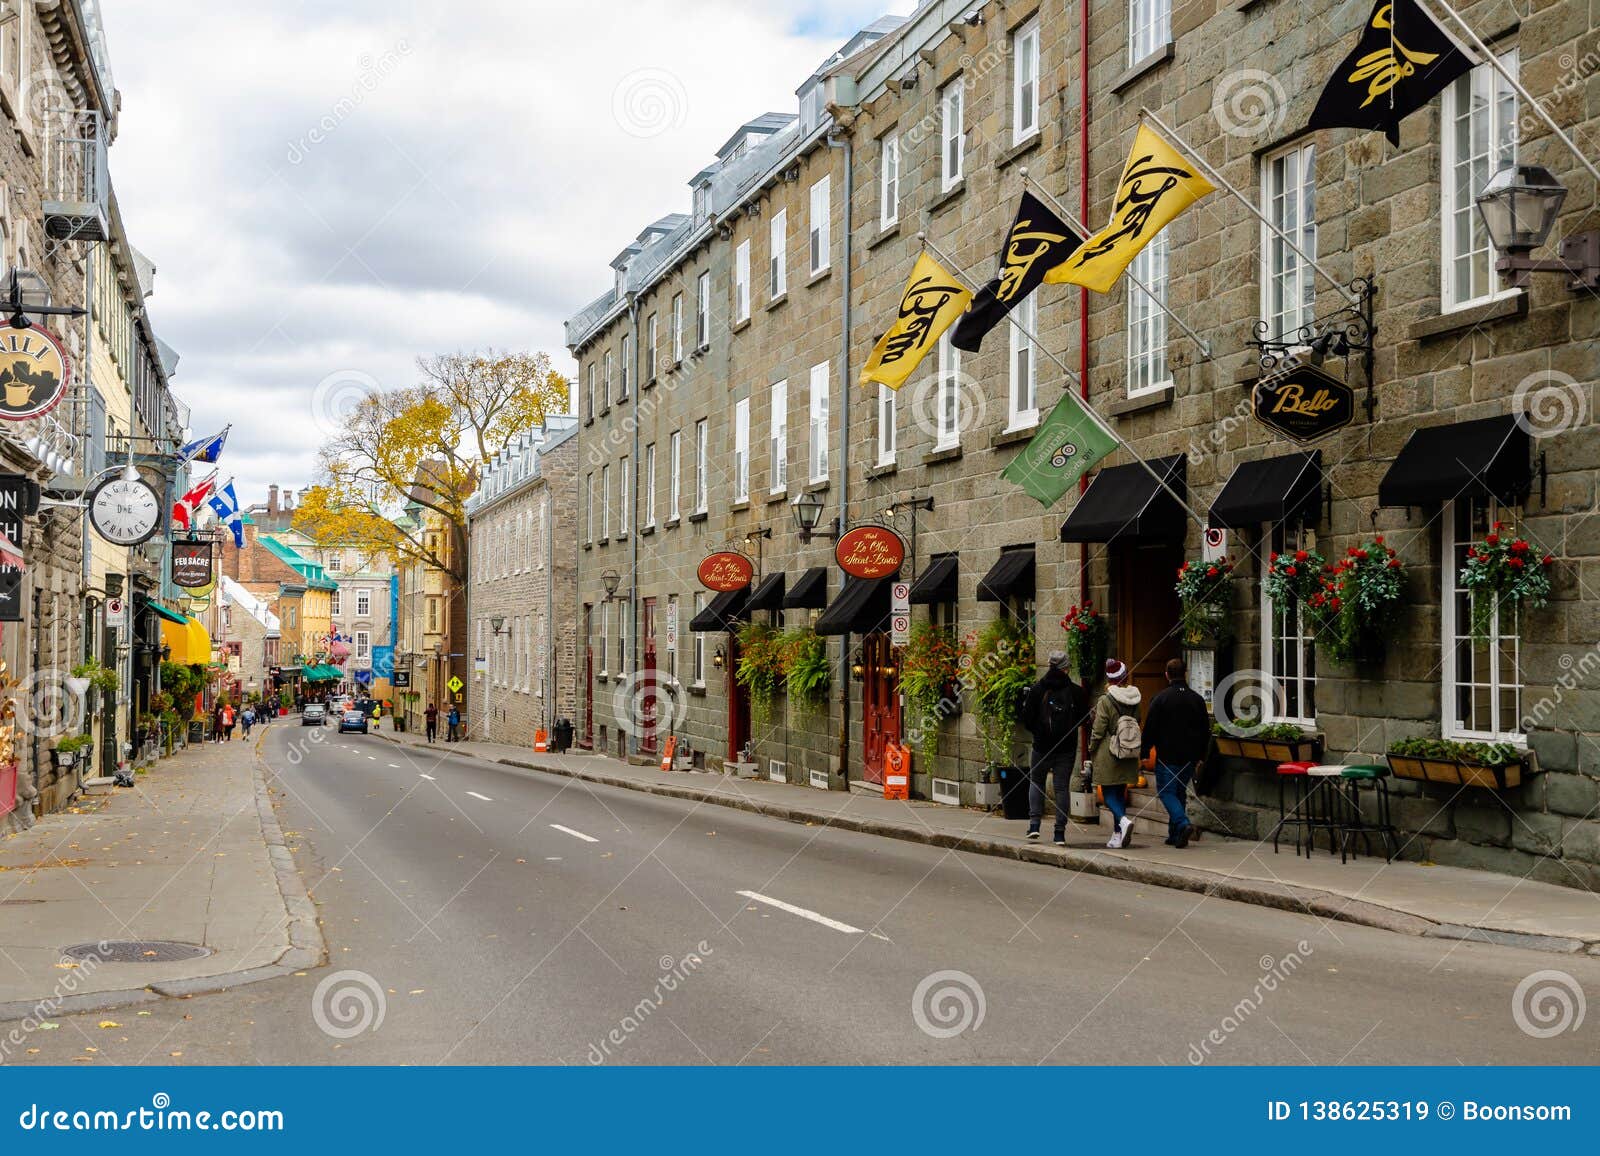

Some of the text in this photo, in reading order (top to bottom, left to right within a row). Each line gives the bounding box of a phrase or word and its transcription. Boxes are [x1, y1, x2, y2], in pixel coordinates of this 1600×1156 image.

[1271, 384, 1340, 417] Bello
[98, 483, 154, 508] BAGAGES
[102, 520, 149, 537] FRANCE
[175, 557, 188, 566] FEU
